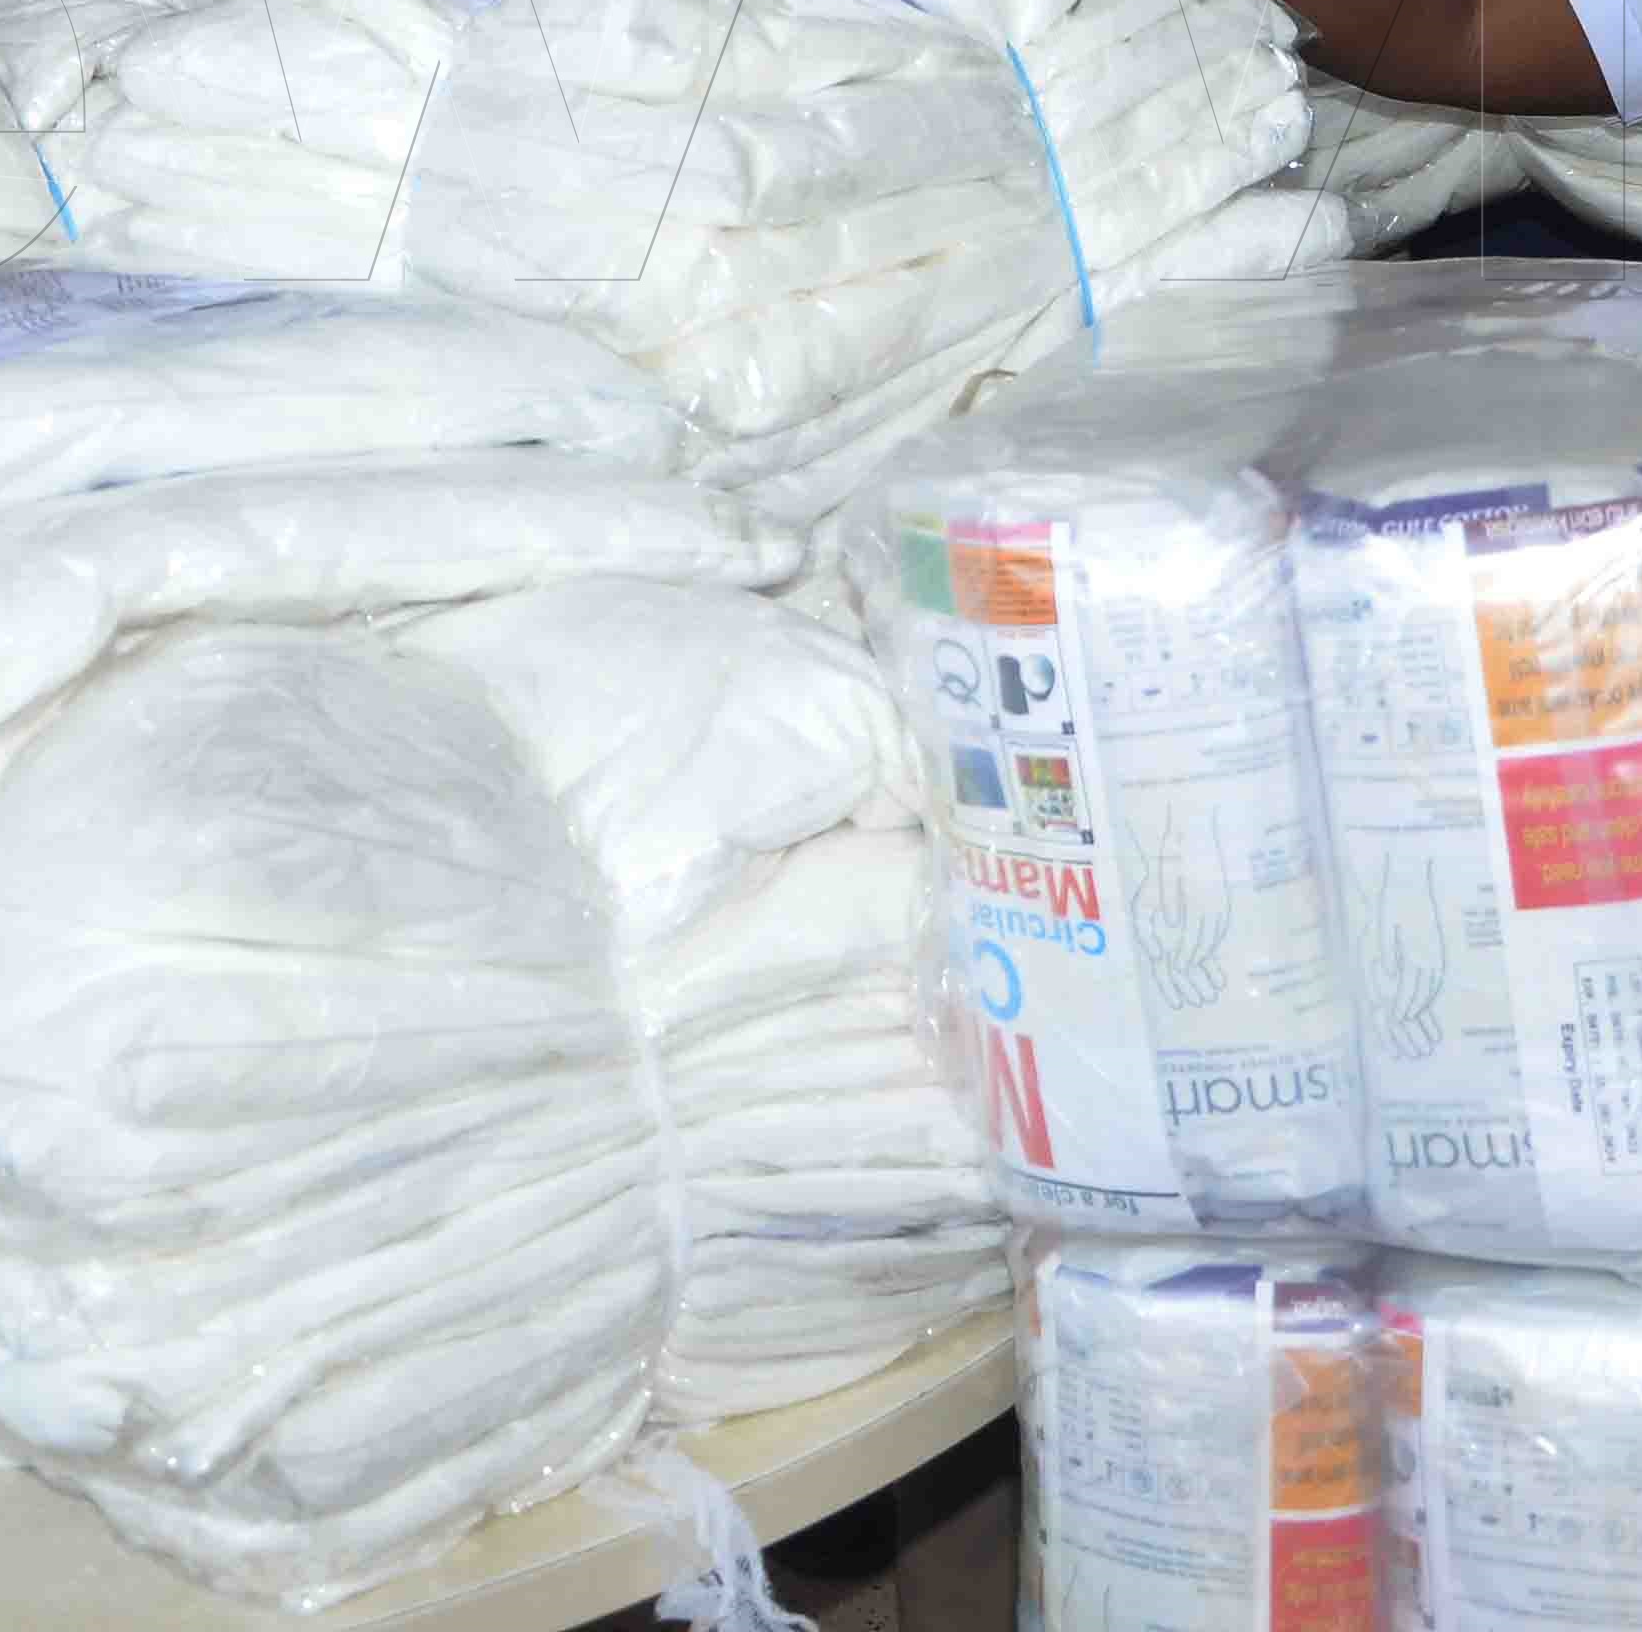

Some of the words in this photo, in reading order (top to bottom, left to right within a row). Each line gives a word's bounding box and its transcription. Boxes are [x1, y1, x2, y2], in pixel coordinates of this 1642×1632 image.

[971, 939, 1024, 1021] C
[1559, 1022, 1578, 1074] Expiry
[1568, 1077, 1584, 1114] Date
[1079, 1190, 1096, 1206] a
[1101, 1194, 1142, 1217] for
